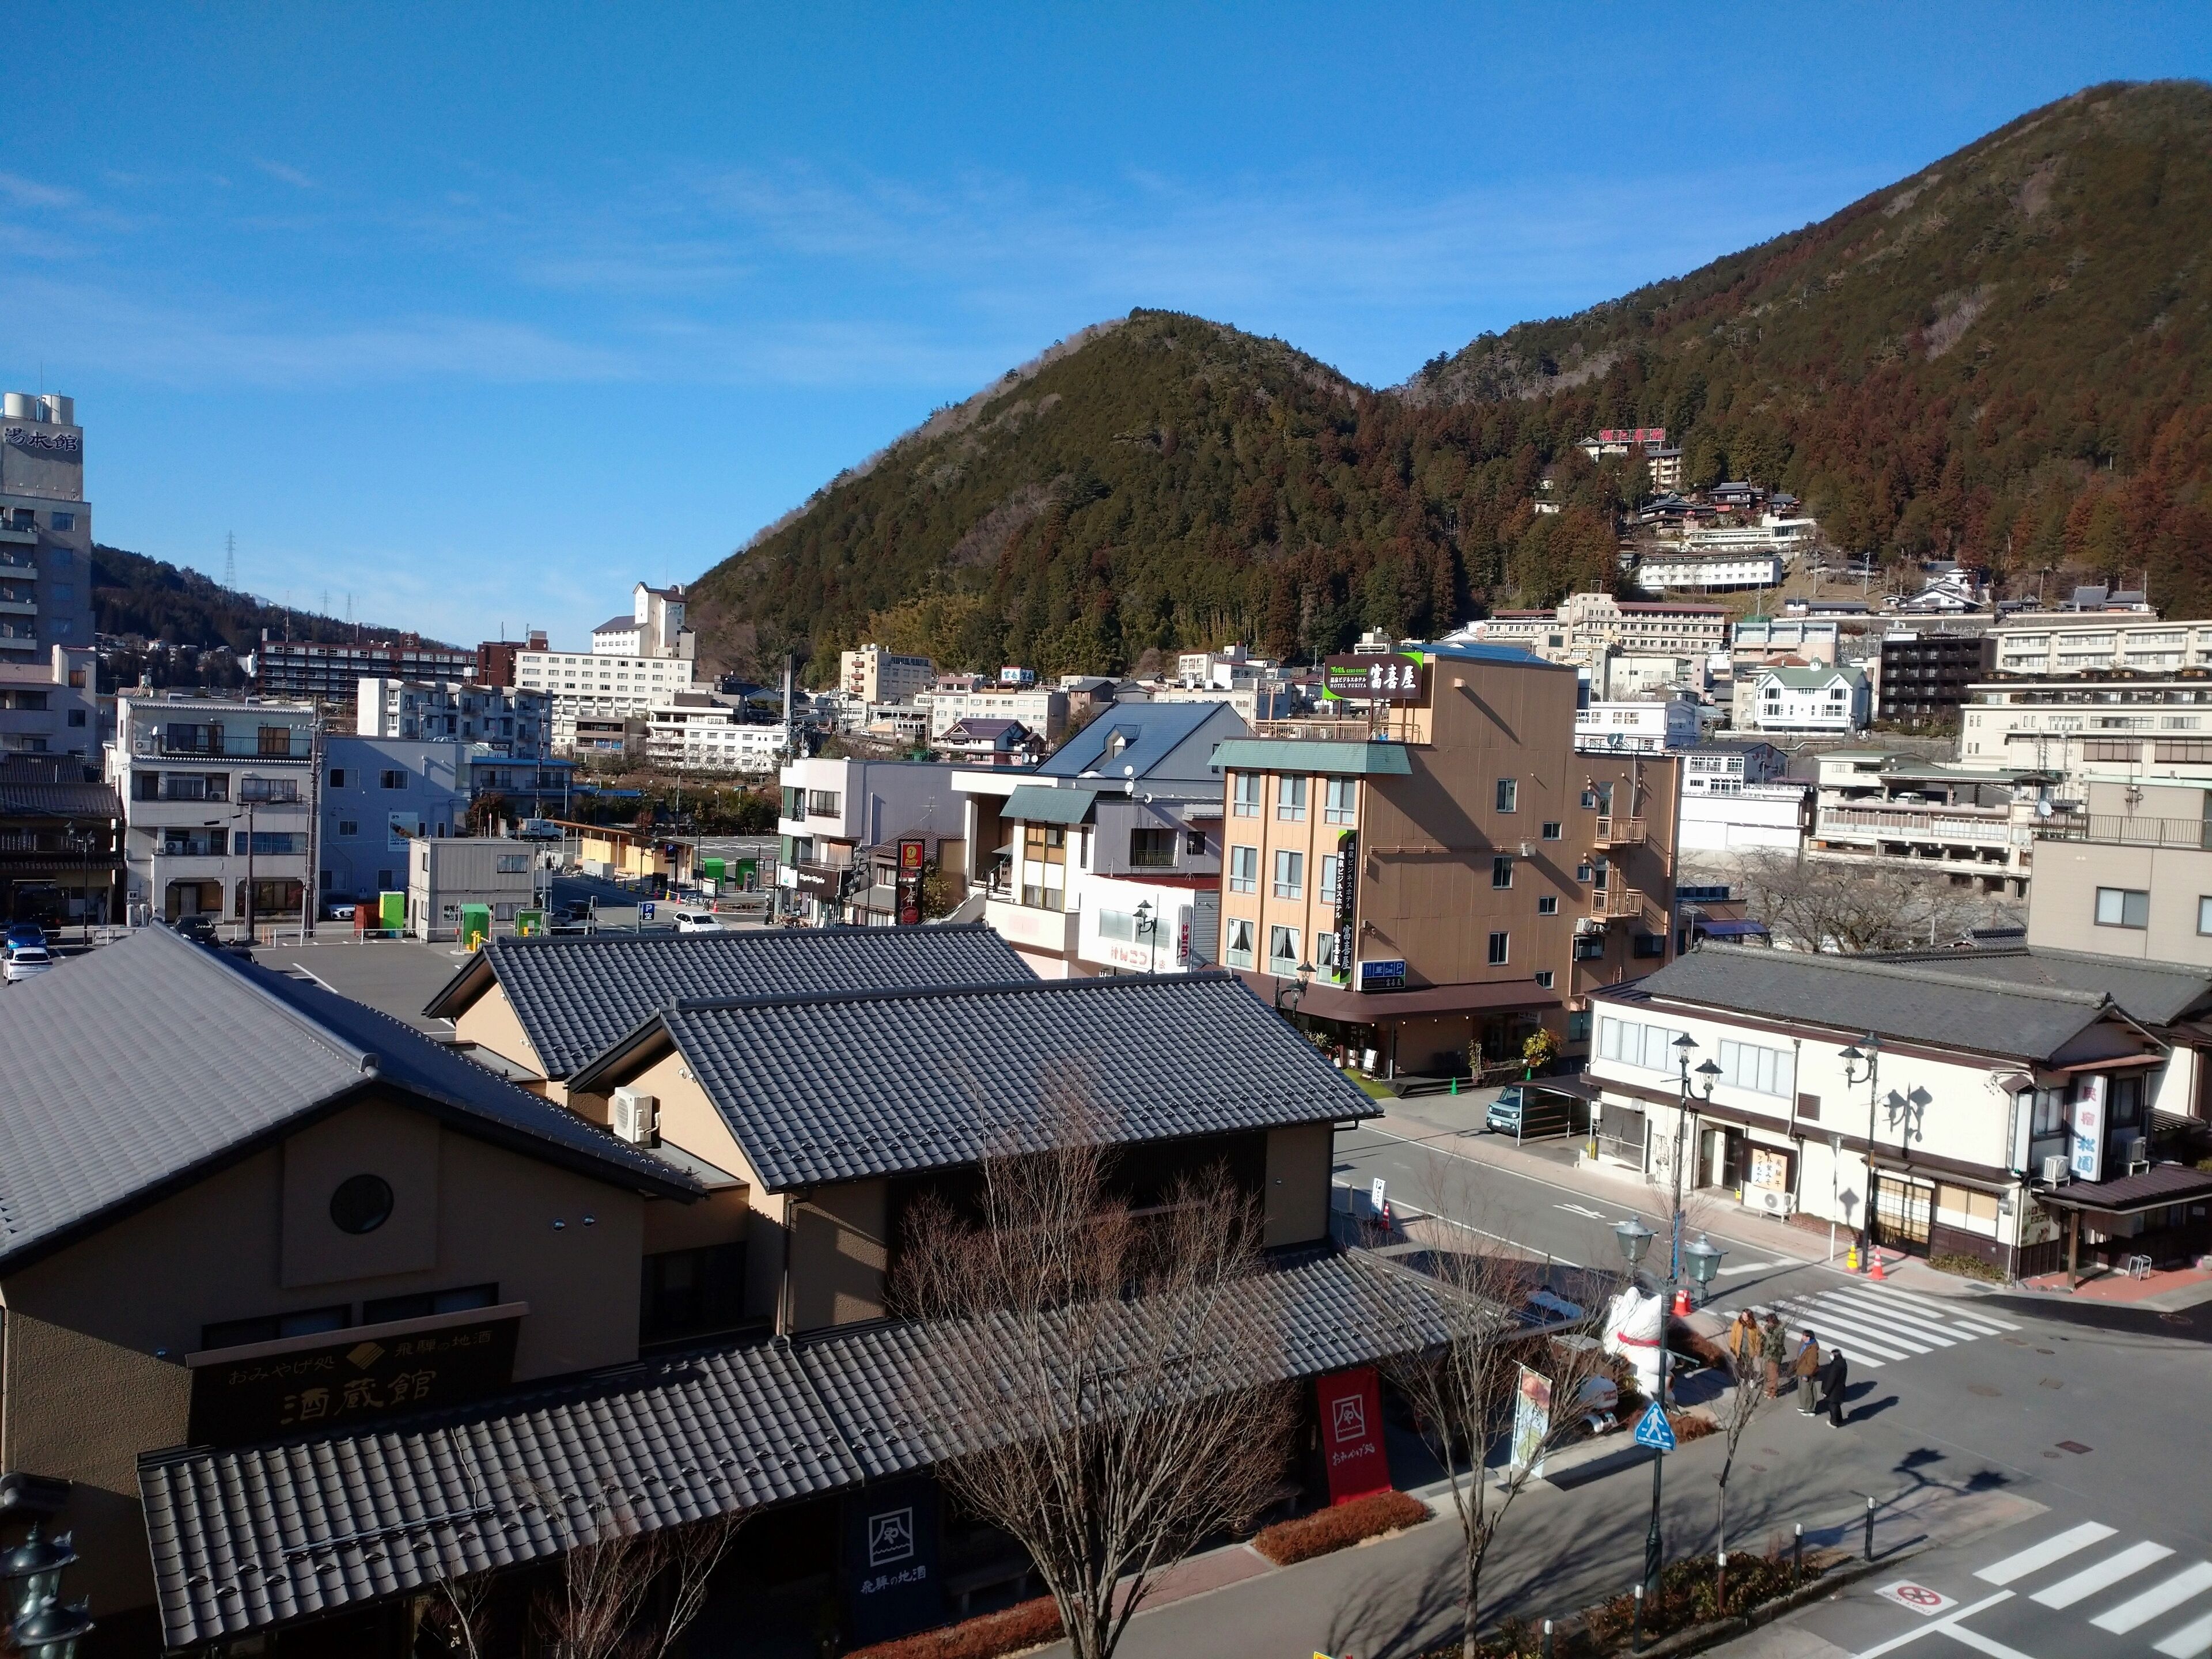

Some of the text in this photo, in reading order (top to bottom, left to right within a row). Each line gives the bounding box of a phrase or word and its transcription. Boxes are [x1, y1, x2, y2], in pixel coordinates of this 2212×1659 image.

[3, 427, 78, 451] 湯本館
[1371, 664, 1416, 689] 富喜屋
[1345, 842, 1354, 910] 温泉ビジネスホテル
[645, 904, 653, 912] P
[1333, 851, 1345, 966] 温泉ビジネスホテル 富喜屋
[1341, 925, 1351, 969] 富喜屋
[1396, 963, 1403, 971] P
[394, 1330, 493, 1357] 飛騨の地酒
[229, 1355, 335, 1385] おみやげ処
[280, 1368, 436, 1425] 酒蔵館
[861, 1565, 926, 1594] 飛騨の地酒
